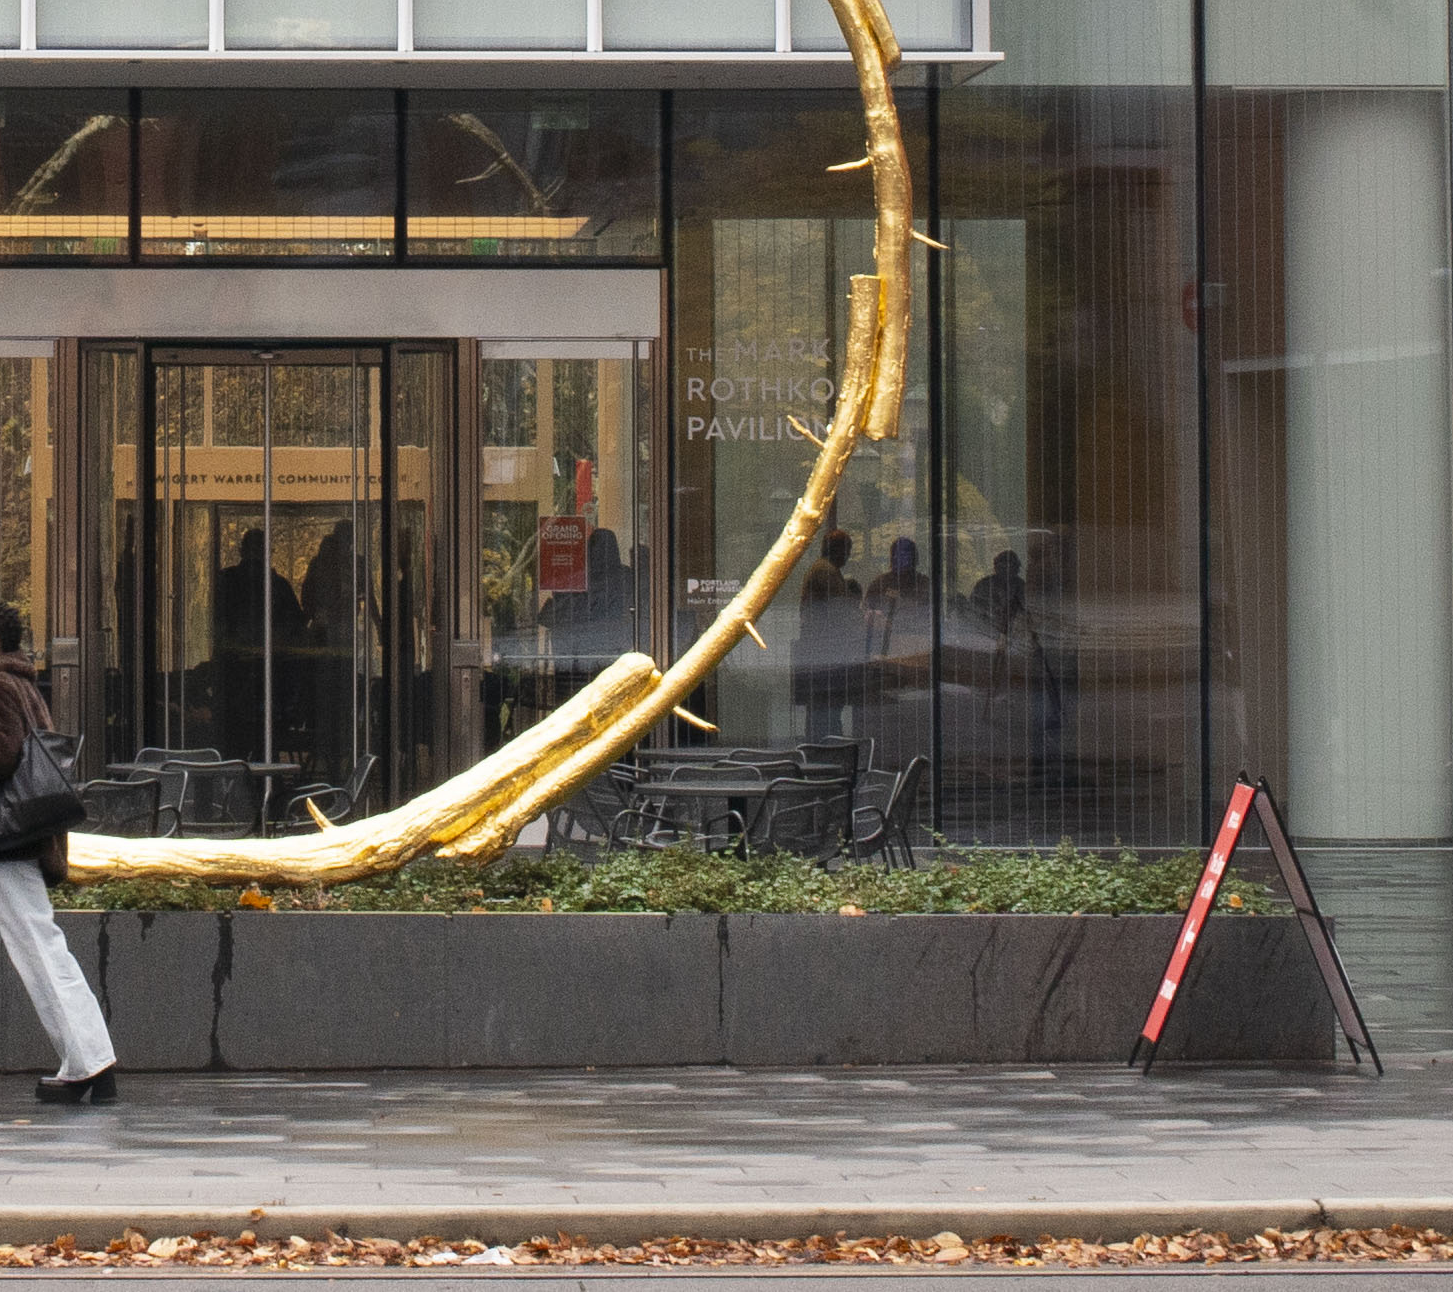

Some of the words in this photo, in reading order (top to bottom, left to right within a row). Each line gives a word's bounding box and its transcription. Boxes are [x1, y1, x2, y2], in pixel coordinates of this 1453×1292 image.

[686, 347, 726, 363] THE
[733, 338, 833, 363] MARK
[687, 377, 835, 402] ROTHKO
[687, 416, 834, 441] PAVILION
